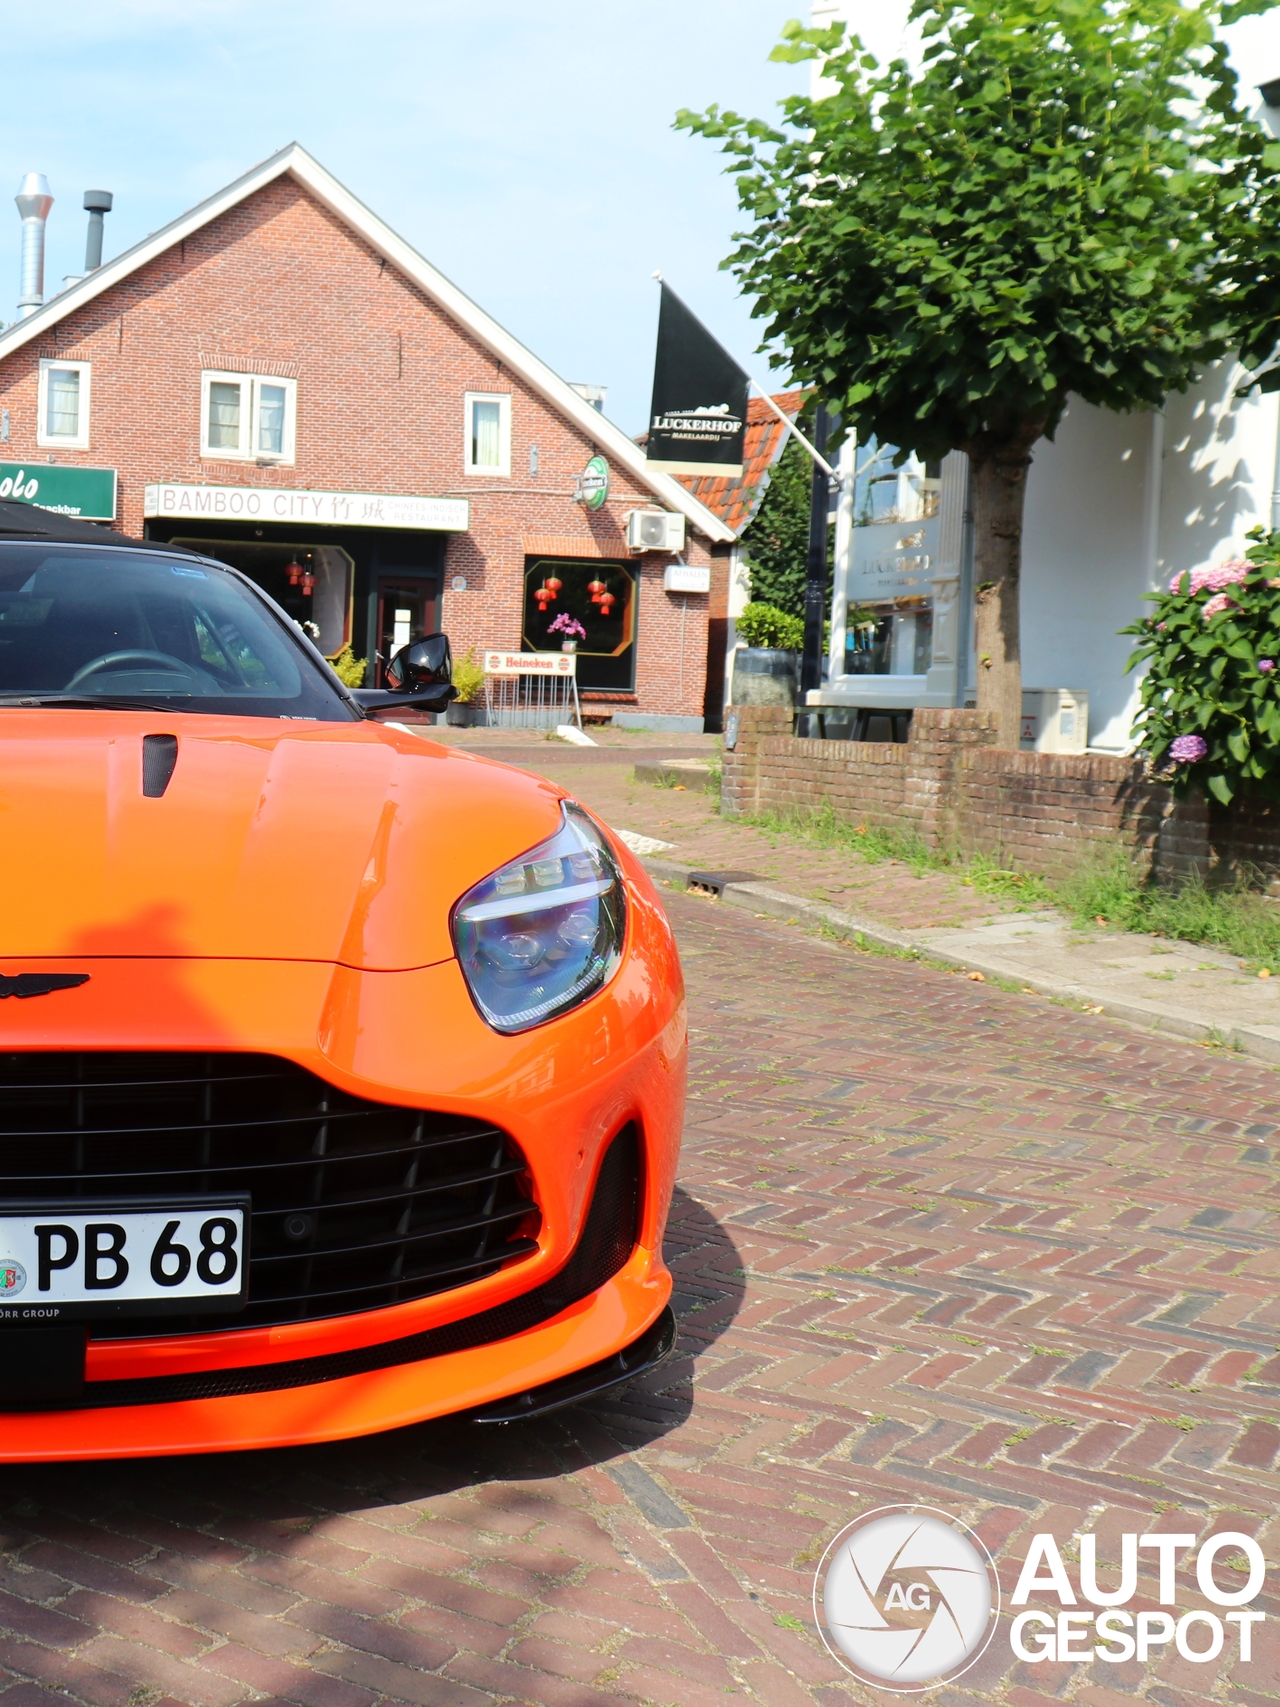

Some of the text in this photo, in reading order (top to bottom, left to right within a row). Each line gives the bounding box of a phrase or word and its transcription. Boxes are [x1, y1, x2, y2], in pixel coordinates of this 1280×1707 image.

[652, 415, 743, 433] LUCKERHOF
[671, 432, 721, 442] MAKELAARDIJ
[162, 489, 262, 515] BAMBOO
[273, 494, 324, 517] CITY
[388, 501, 466, 514] CHINEES-INDISCH
[394, 512, 461, 523] RESTAURANT
[673, 569, 708, 579] AFHALEN
[505, 656, 554, 669] Heineken
[34, 1223, 130, 1292] PB
[150, 1217, 238, 1287] 68
[22, 1309, 60, 1319] GROUP
